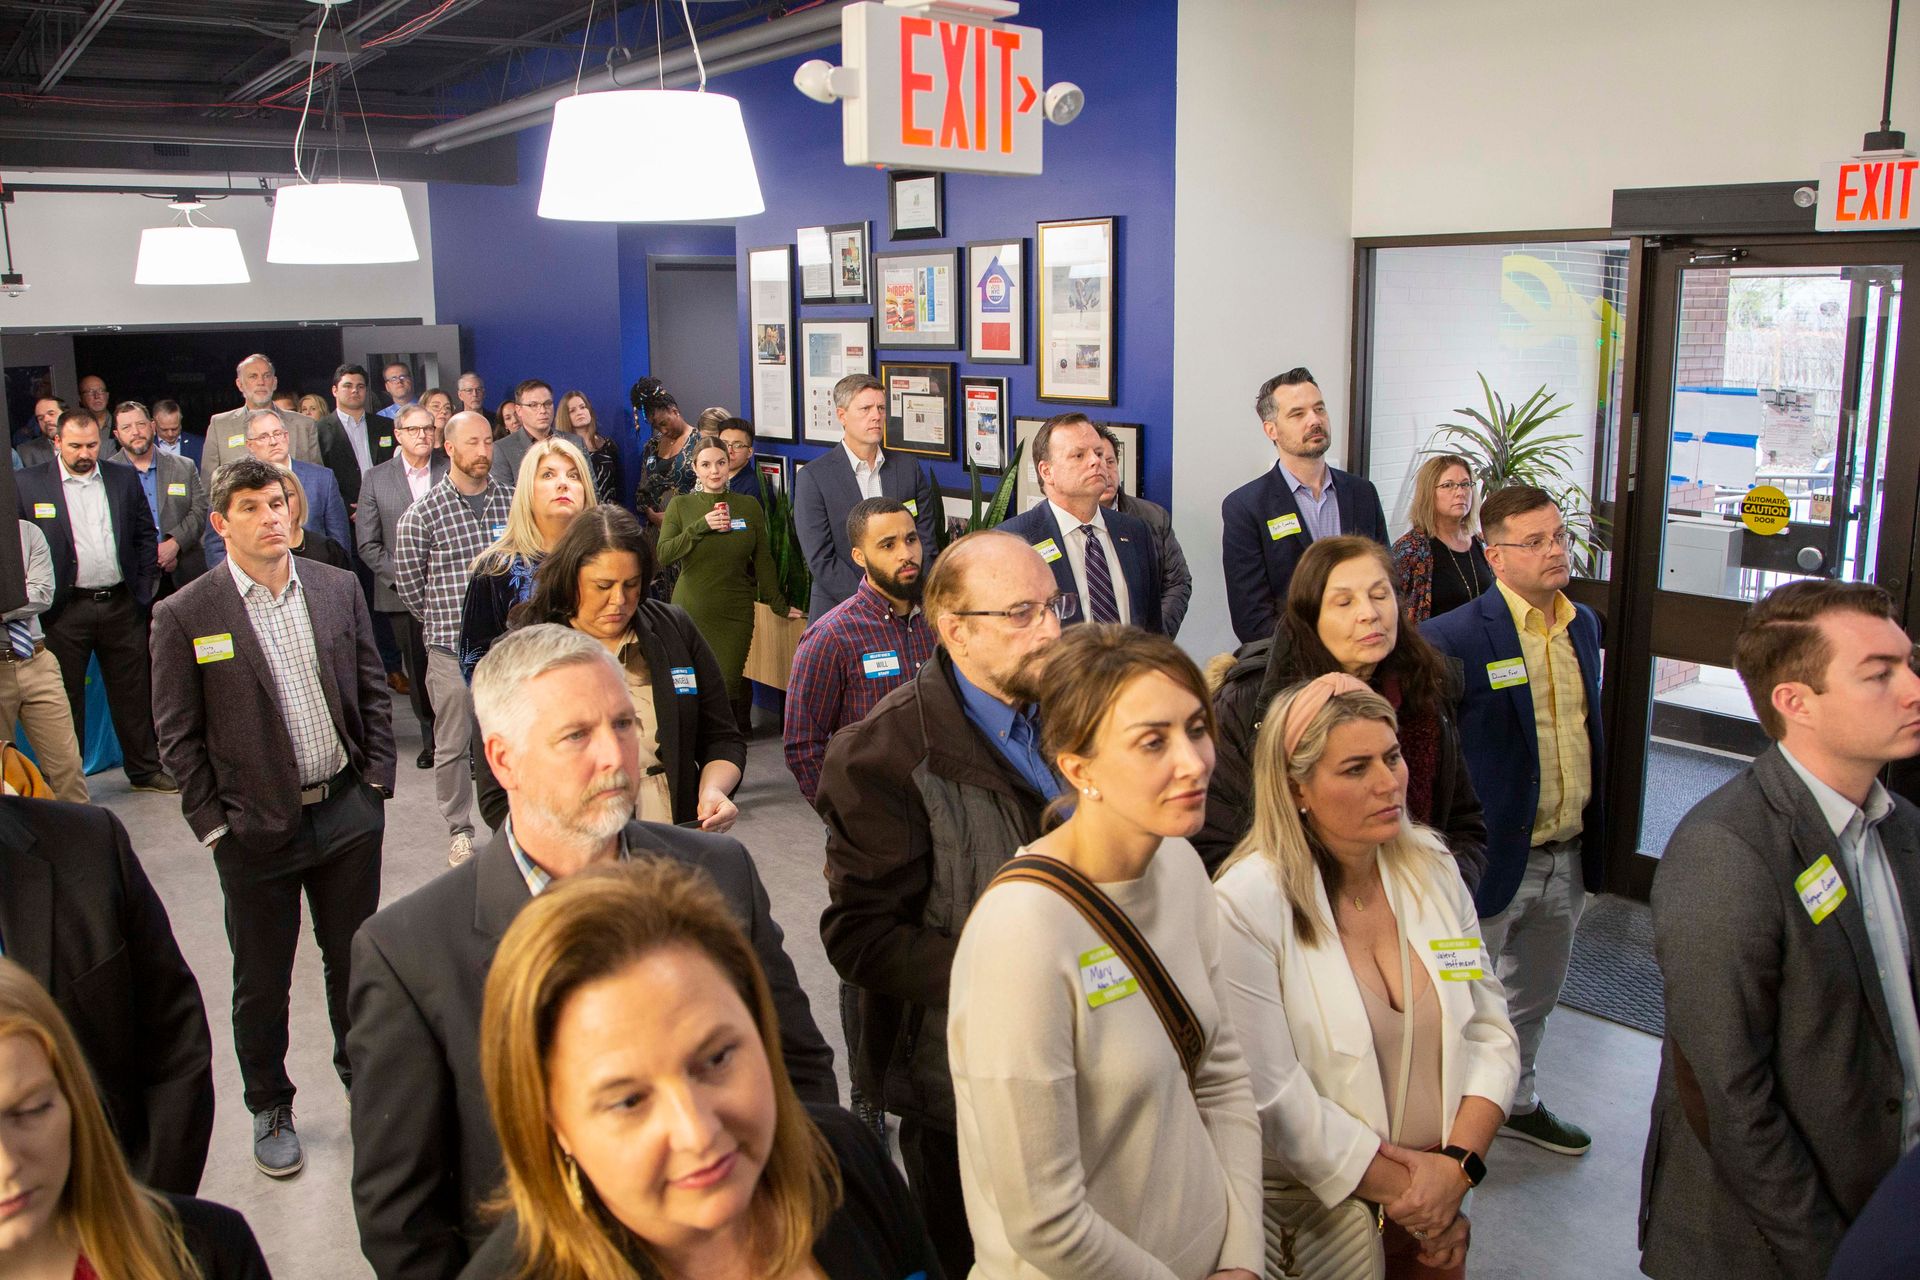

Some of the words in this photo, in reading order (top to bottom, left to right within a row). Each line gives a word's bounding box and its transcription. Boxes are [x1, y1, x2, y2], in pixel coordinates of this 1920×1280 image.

[900, 16, 1022, 154] EXIT
[1836, 161, 1919, 221] EXIT
[1746, 495, 1787, 506] AUTOMATIC
[1743, 504, 1789, 517] CAUTION
[1754, 516, 1776, 525] DOOR
